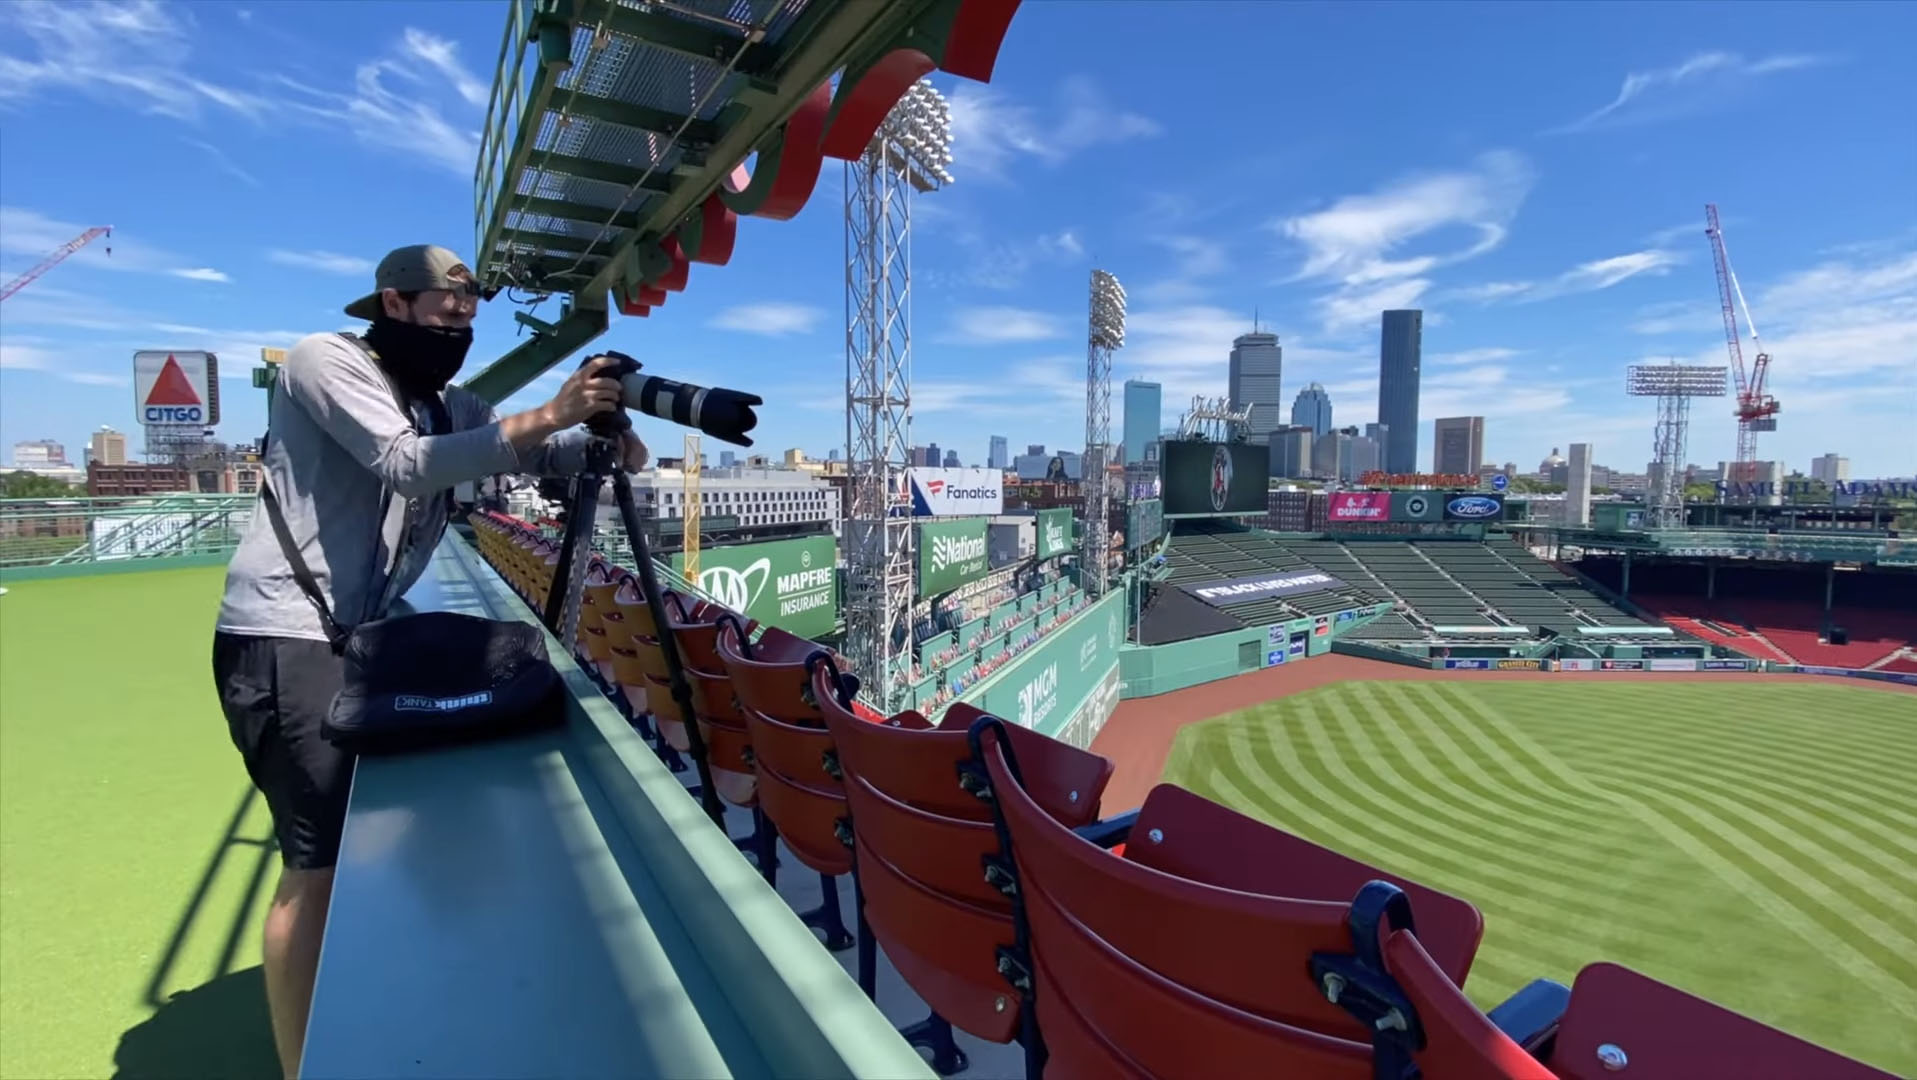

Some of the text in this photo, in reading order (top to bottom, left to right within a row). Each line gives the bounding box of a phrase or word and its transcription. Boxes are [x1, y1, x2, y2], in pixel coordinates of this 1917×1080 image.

[146, 407, 202, 422] CITGO
[946, 485, 997, 500] Fanatics
[1456, 501, 1490, 514] Ford
[945, 532, 986, 566] National
[777, 566, 832, 594] MAPFRE
[781, 590, 831, 617] INSURANCE
[1033, 660, 1058, 707] MGM
